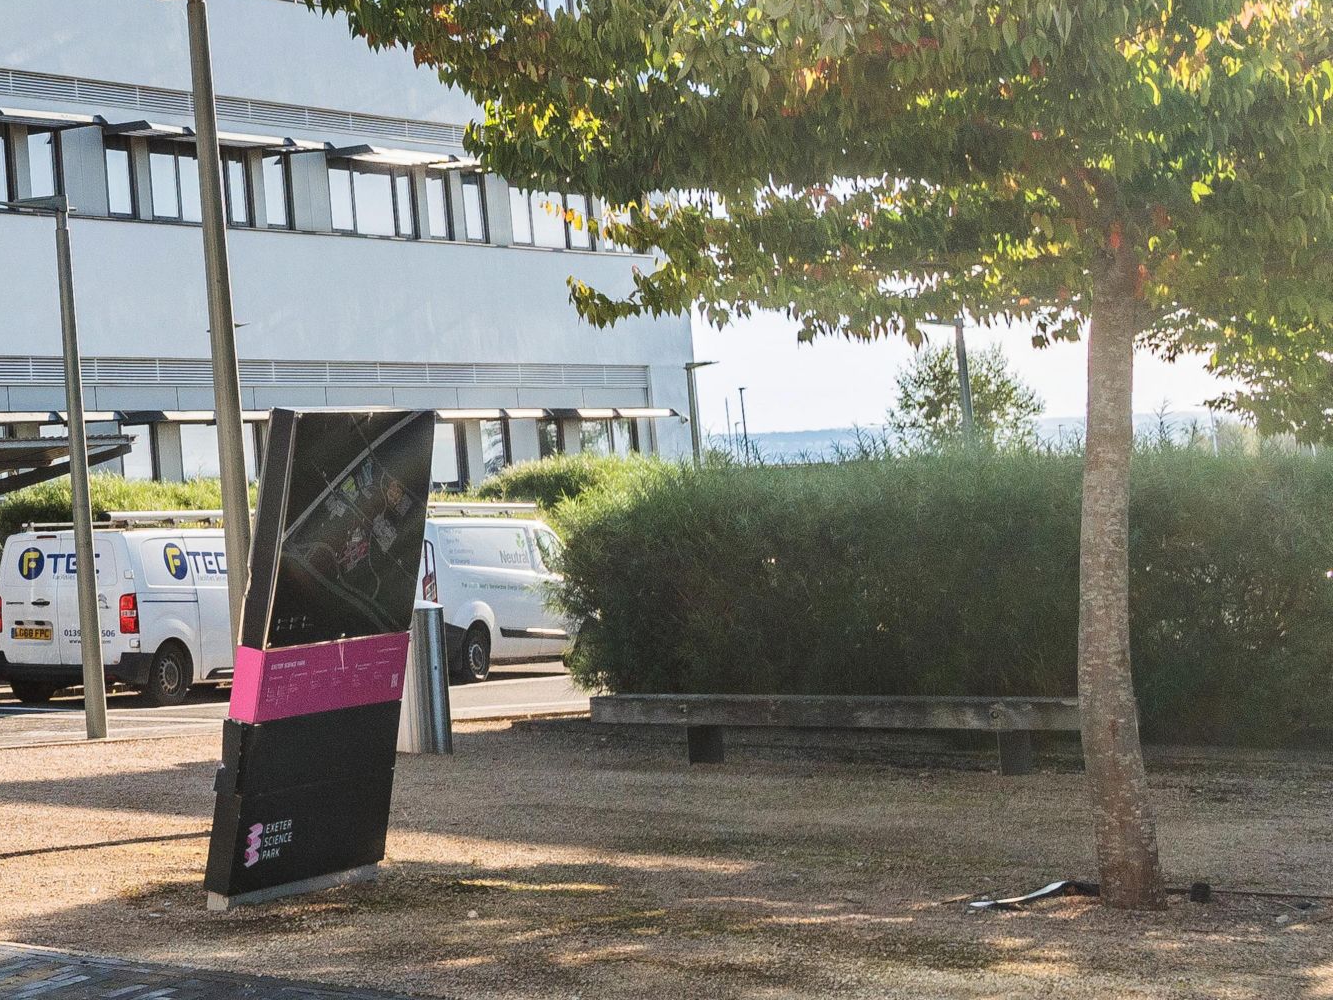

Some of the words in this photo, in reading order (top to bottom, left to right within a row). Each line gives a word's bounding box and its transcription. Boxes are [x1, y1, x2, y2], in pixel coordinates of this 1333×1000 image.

[499, 550, 530, 564] Neutral
[265, 819, 293, 834] EXETER
[263, 831, 293, 847] SCIENCE
[261, 847, 281, 860] PARK
